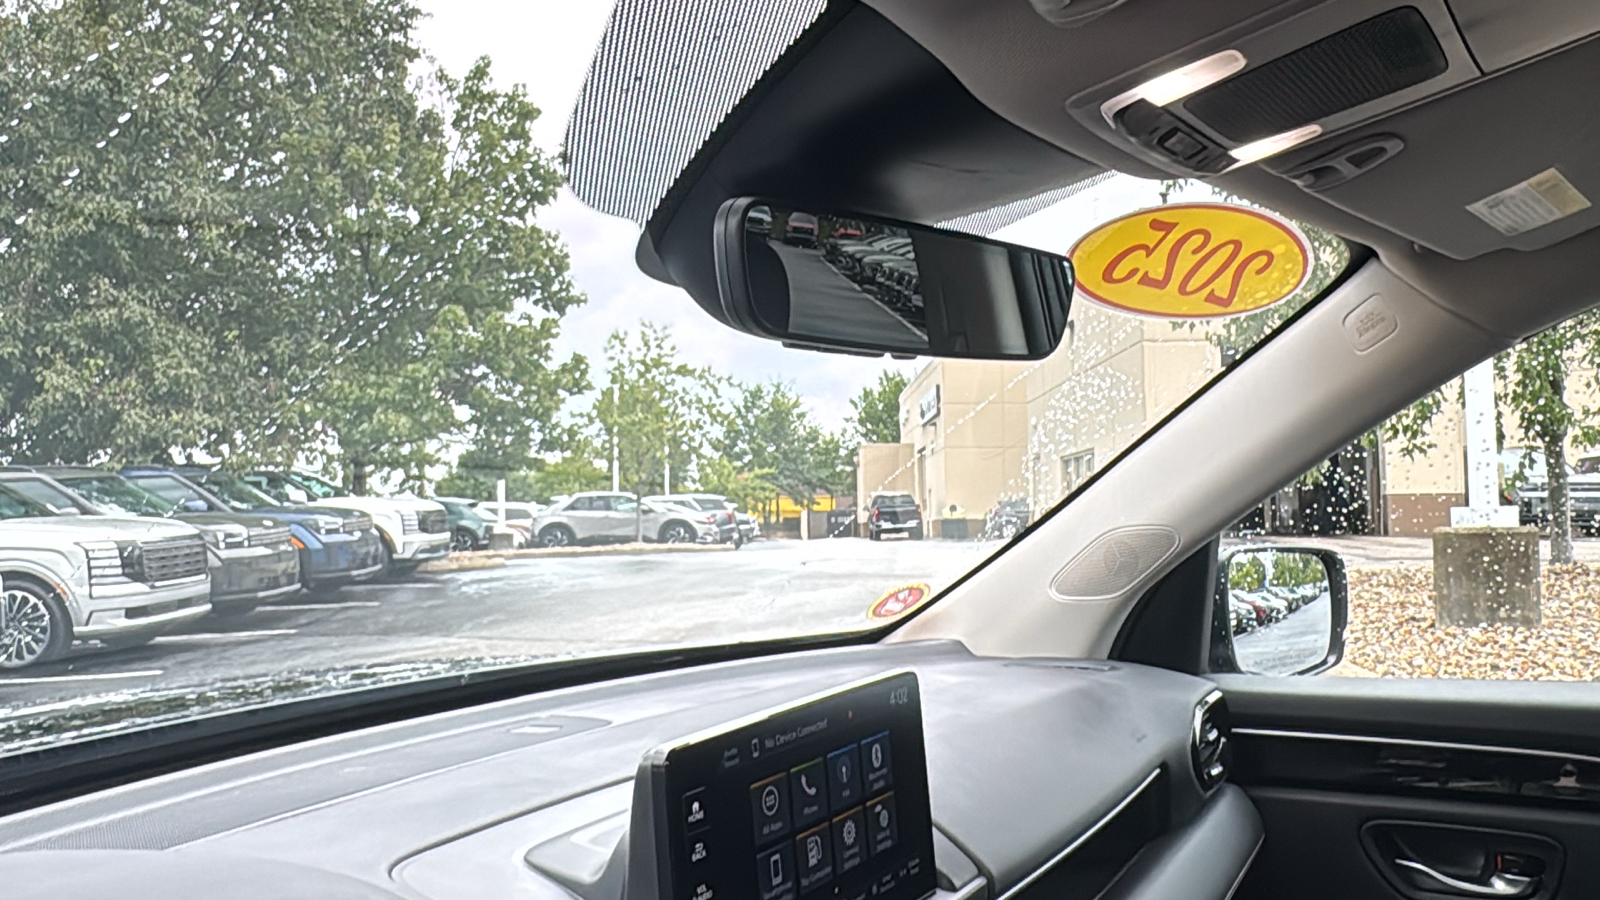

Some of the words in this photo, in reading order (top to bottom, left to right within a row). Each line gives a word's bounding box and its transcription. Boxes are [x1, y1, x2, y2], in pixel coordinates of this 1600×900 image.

[889, 687, 908, 705] 4:02
[765, 738, 775, 749] No
[776, 733, 797, 746] Device
[797, 717, 828, 738] Connected
[688, 810, 704, 823] HOME
